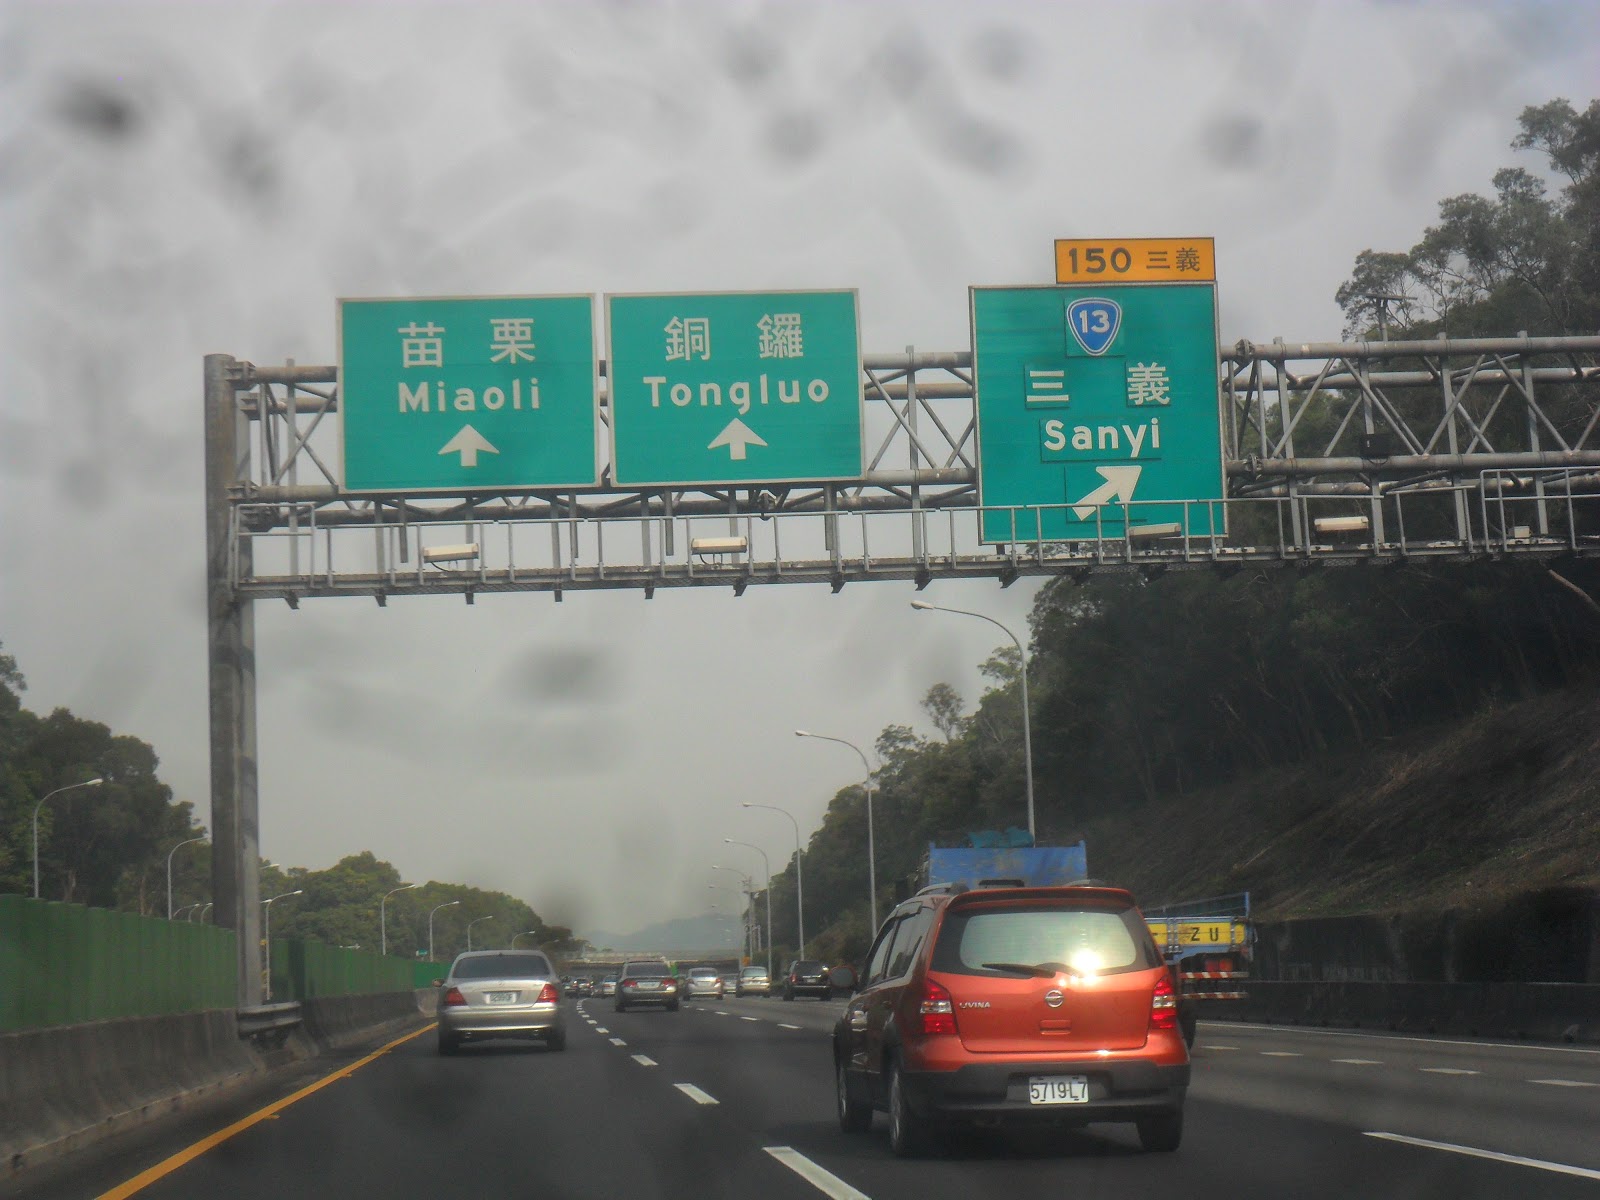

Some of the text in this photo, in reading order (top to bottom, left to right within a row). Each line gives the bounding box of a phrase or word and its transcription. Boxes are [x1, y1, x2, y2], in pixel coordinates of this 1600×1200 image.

[1068, 247, 1201, 274] 150 三義
[663, 312, 804, 362] 銅鑼
[1079, 309, 1111, 334] 13
[397, 317, 537, 369] 苗栗
[398, 377, 540, 413] Miaoli
[643, 373, 830, 415] Tongluo
[1026, 362, 1171, 406] 三義
[1043, 417, 1160, 458] Sanyi
